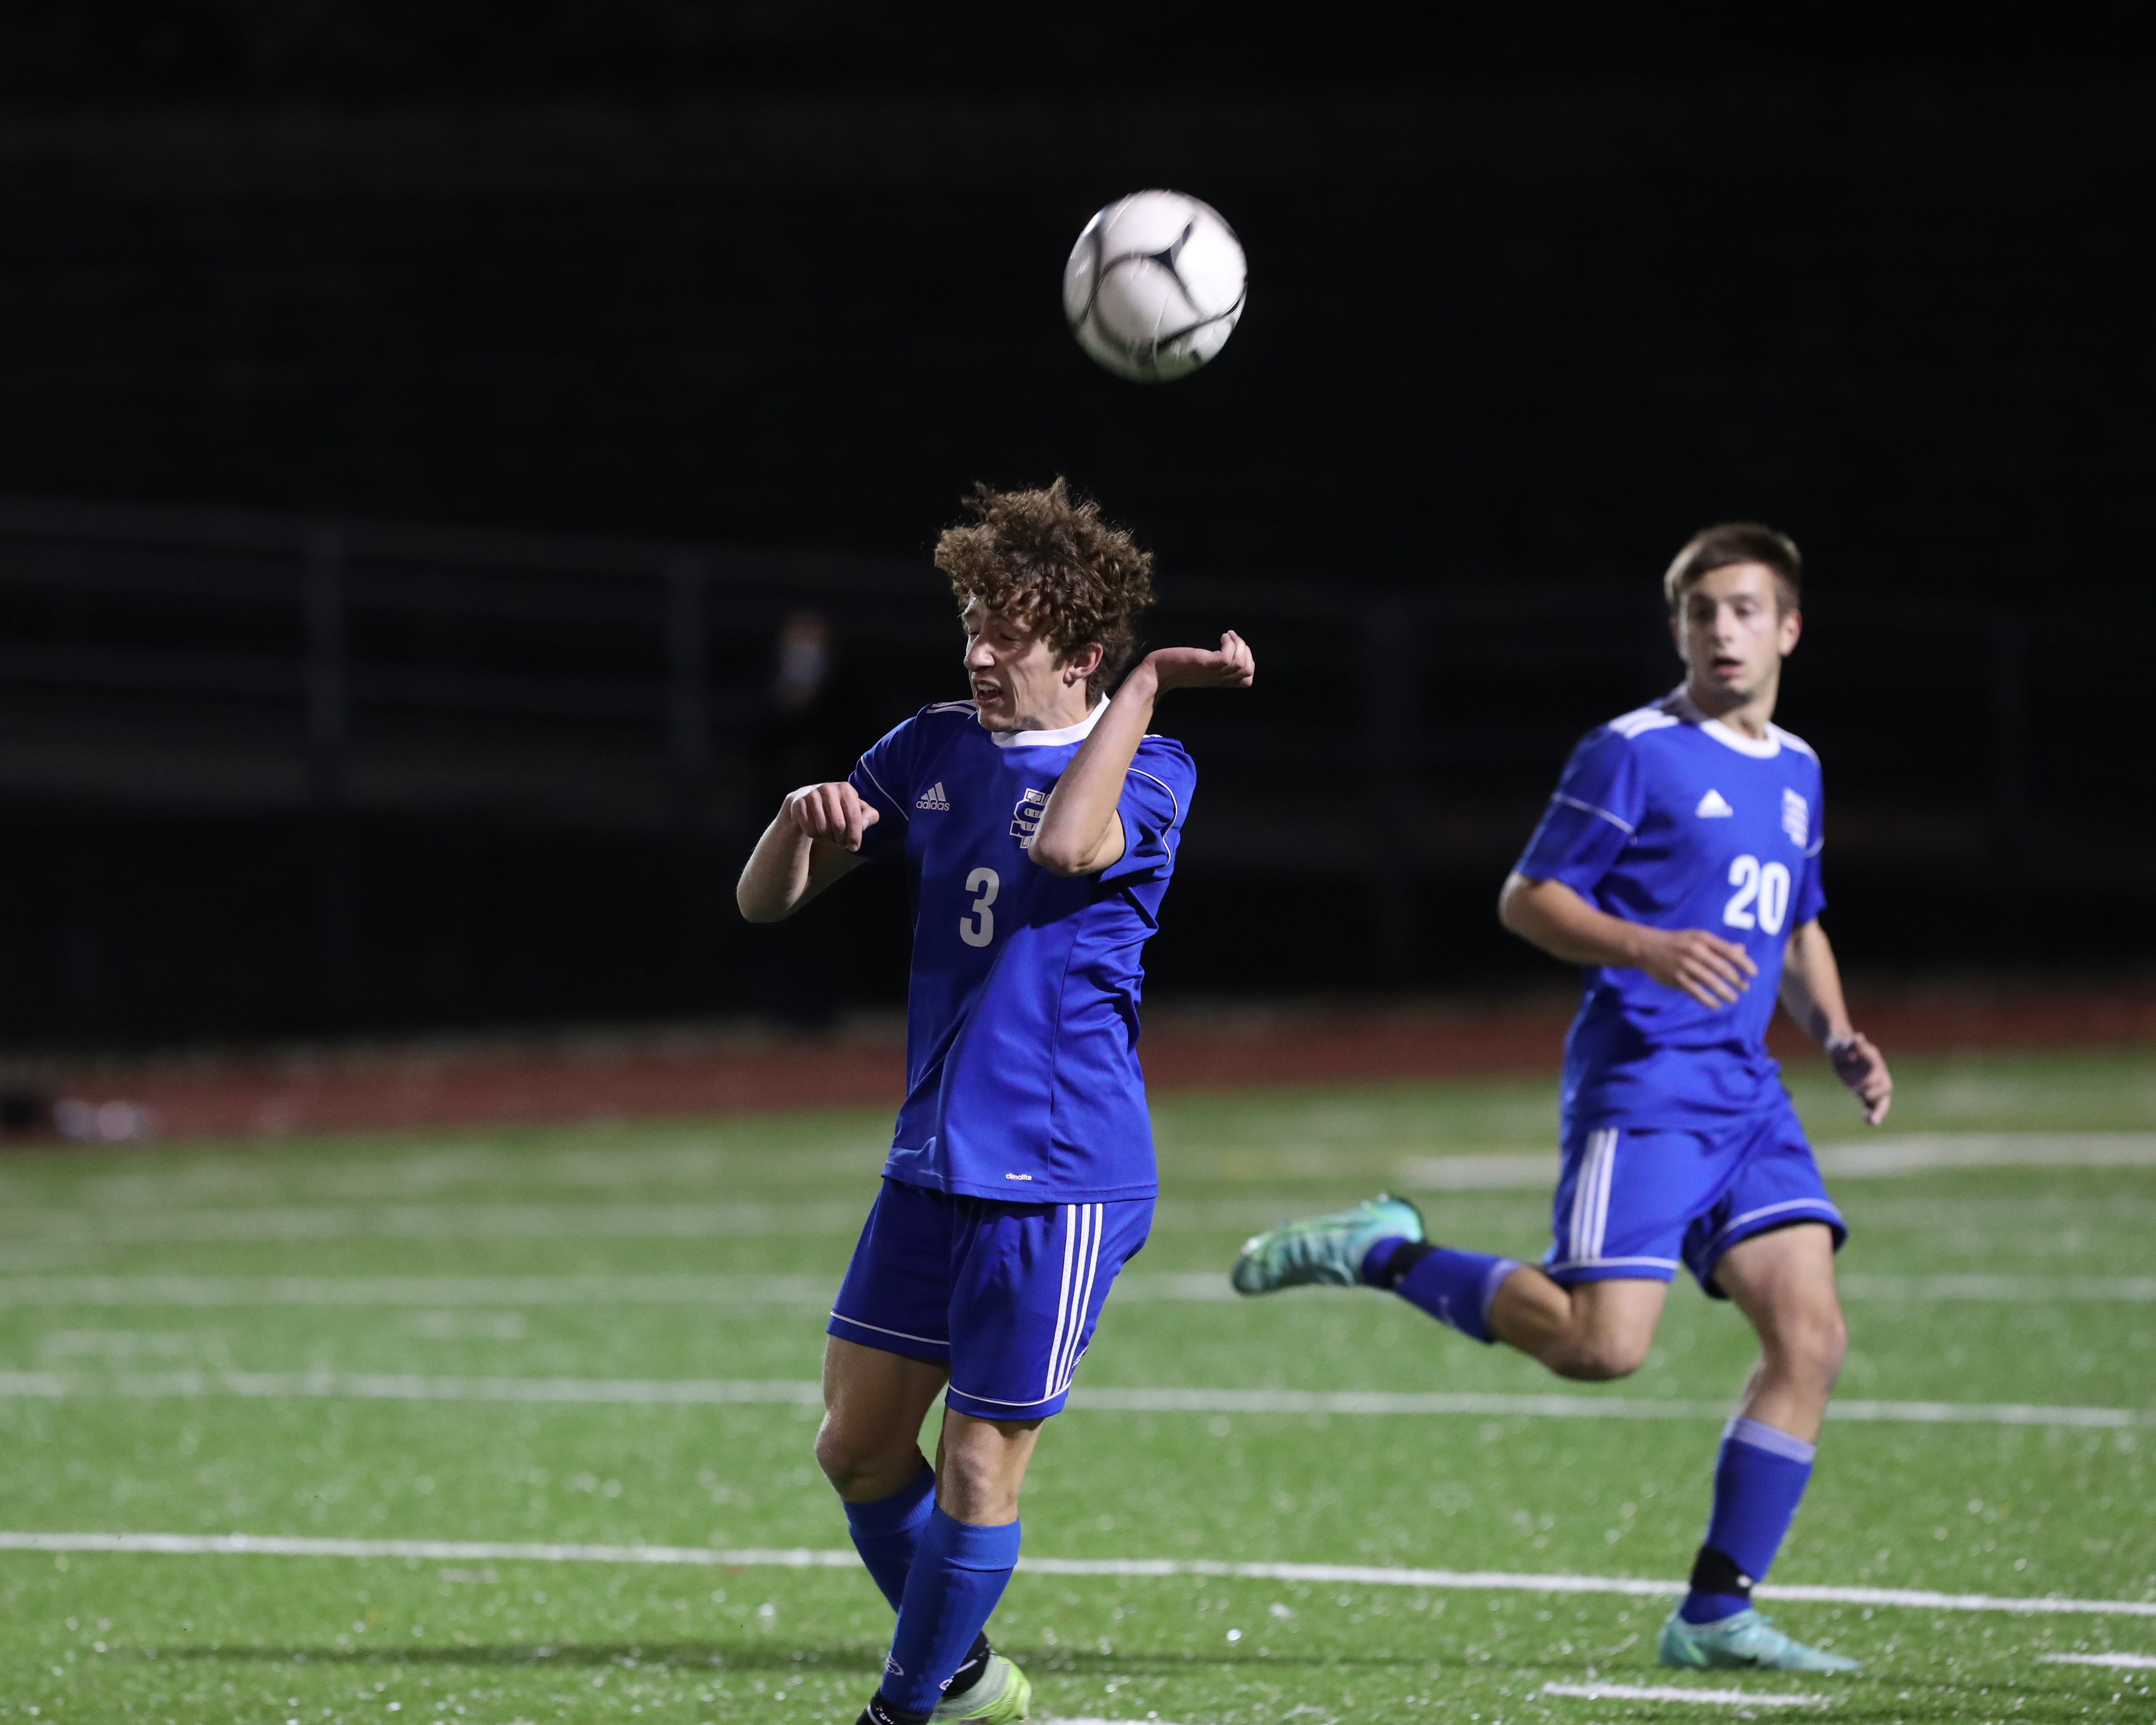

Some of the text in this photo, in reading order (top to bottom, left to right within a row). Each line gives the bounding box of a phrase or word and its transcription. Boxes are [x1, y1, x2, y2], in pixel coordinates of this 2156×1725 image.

[916, 799, 950, 811] adidas
[959, 867, 1000, 948] 3
[1722, 854, 1791, 936] 20
[1005, 1173, 1033, 1181] climalite
